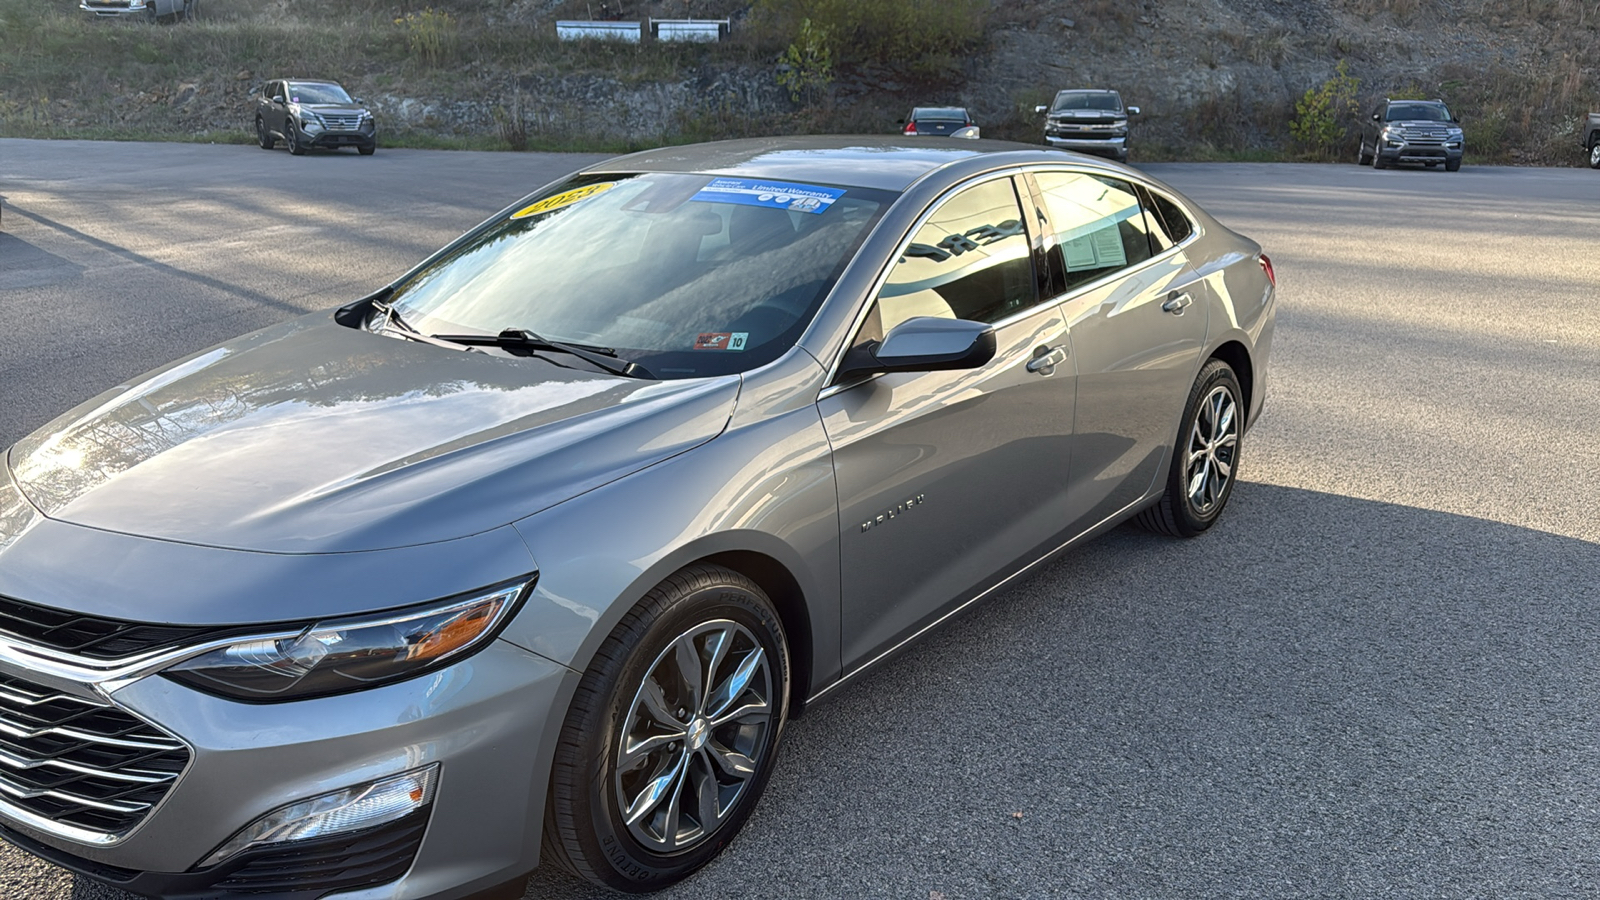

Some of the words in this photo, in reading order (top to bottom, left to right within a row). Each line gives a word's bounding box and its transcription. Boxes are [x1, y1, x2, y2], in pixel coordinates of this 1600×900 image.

[524, 185, 601, 215] 2023
[752, 184, 787, 194] Limited
[787, 188, 833, 199] Warranty
[732, 337, 743, 348] 10
[861, 494, 925, 533] MALIBU
[719, 592, 783, 645] PERFECTUS
